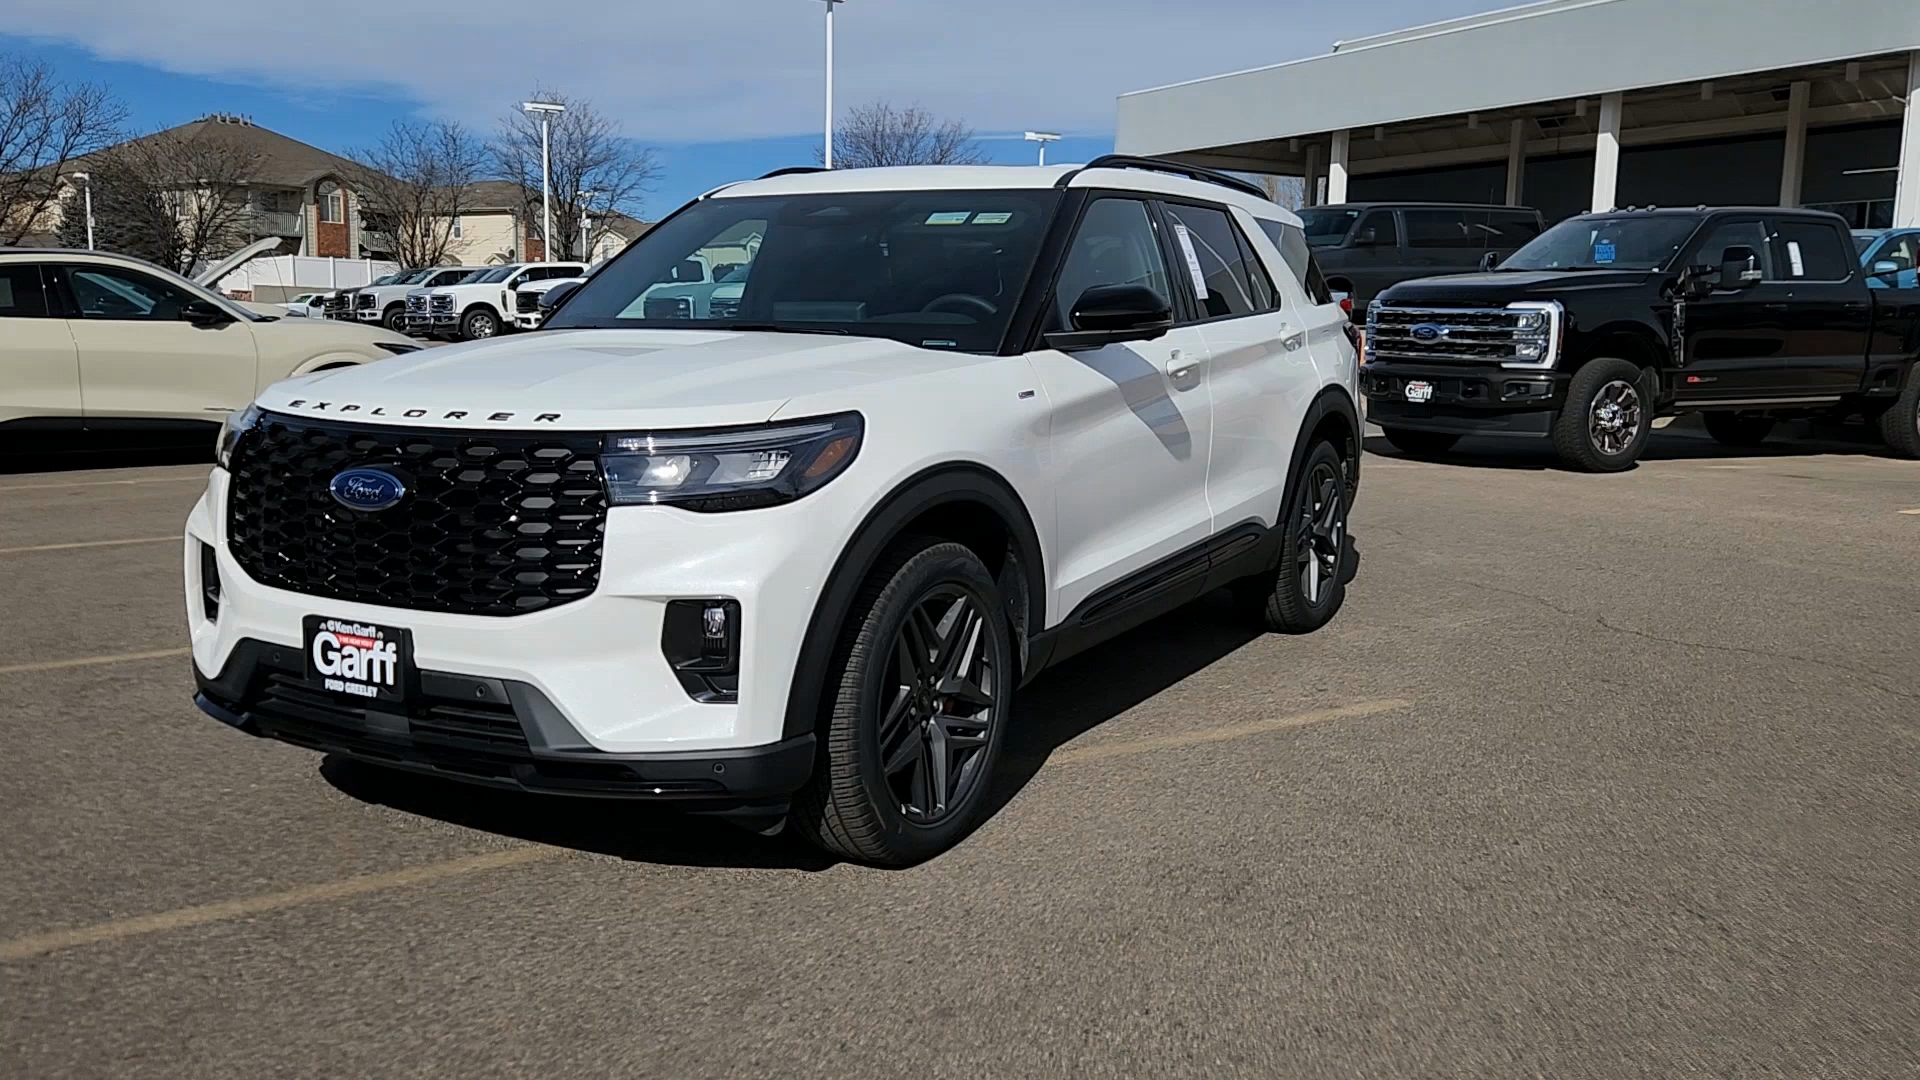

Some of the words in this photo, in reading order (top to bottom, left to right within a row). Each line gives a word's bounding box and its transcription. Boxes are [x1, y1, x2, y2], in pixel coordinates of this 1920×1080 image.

[1405, 384, 1432, 399] Garff
[288, 400, 561, 422] EXPLORER
[343, 476, 385, 501] Ford
[334, 621, 353, 634] Ken
[353, 624, 376, 638] Garff
[312, 631, 397, 686] Garff
